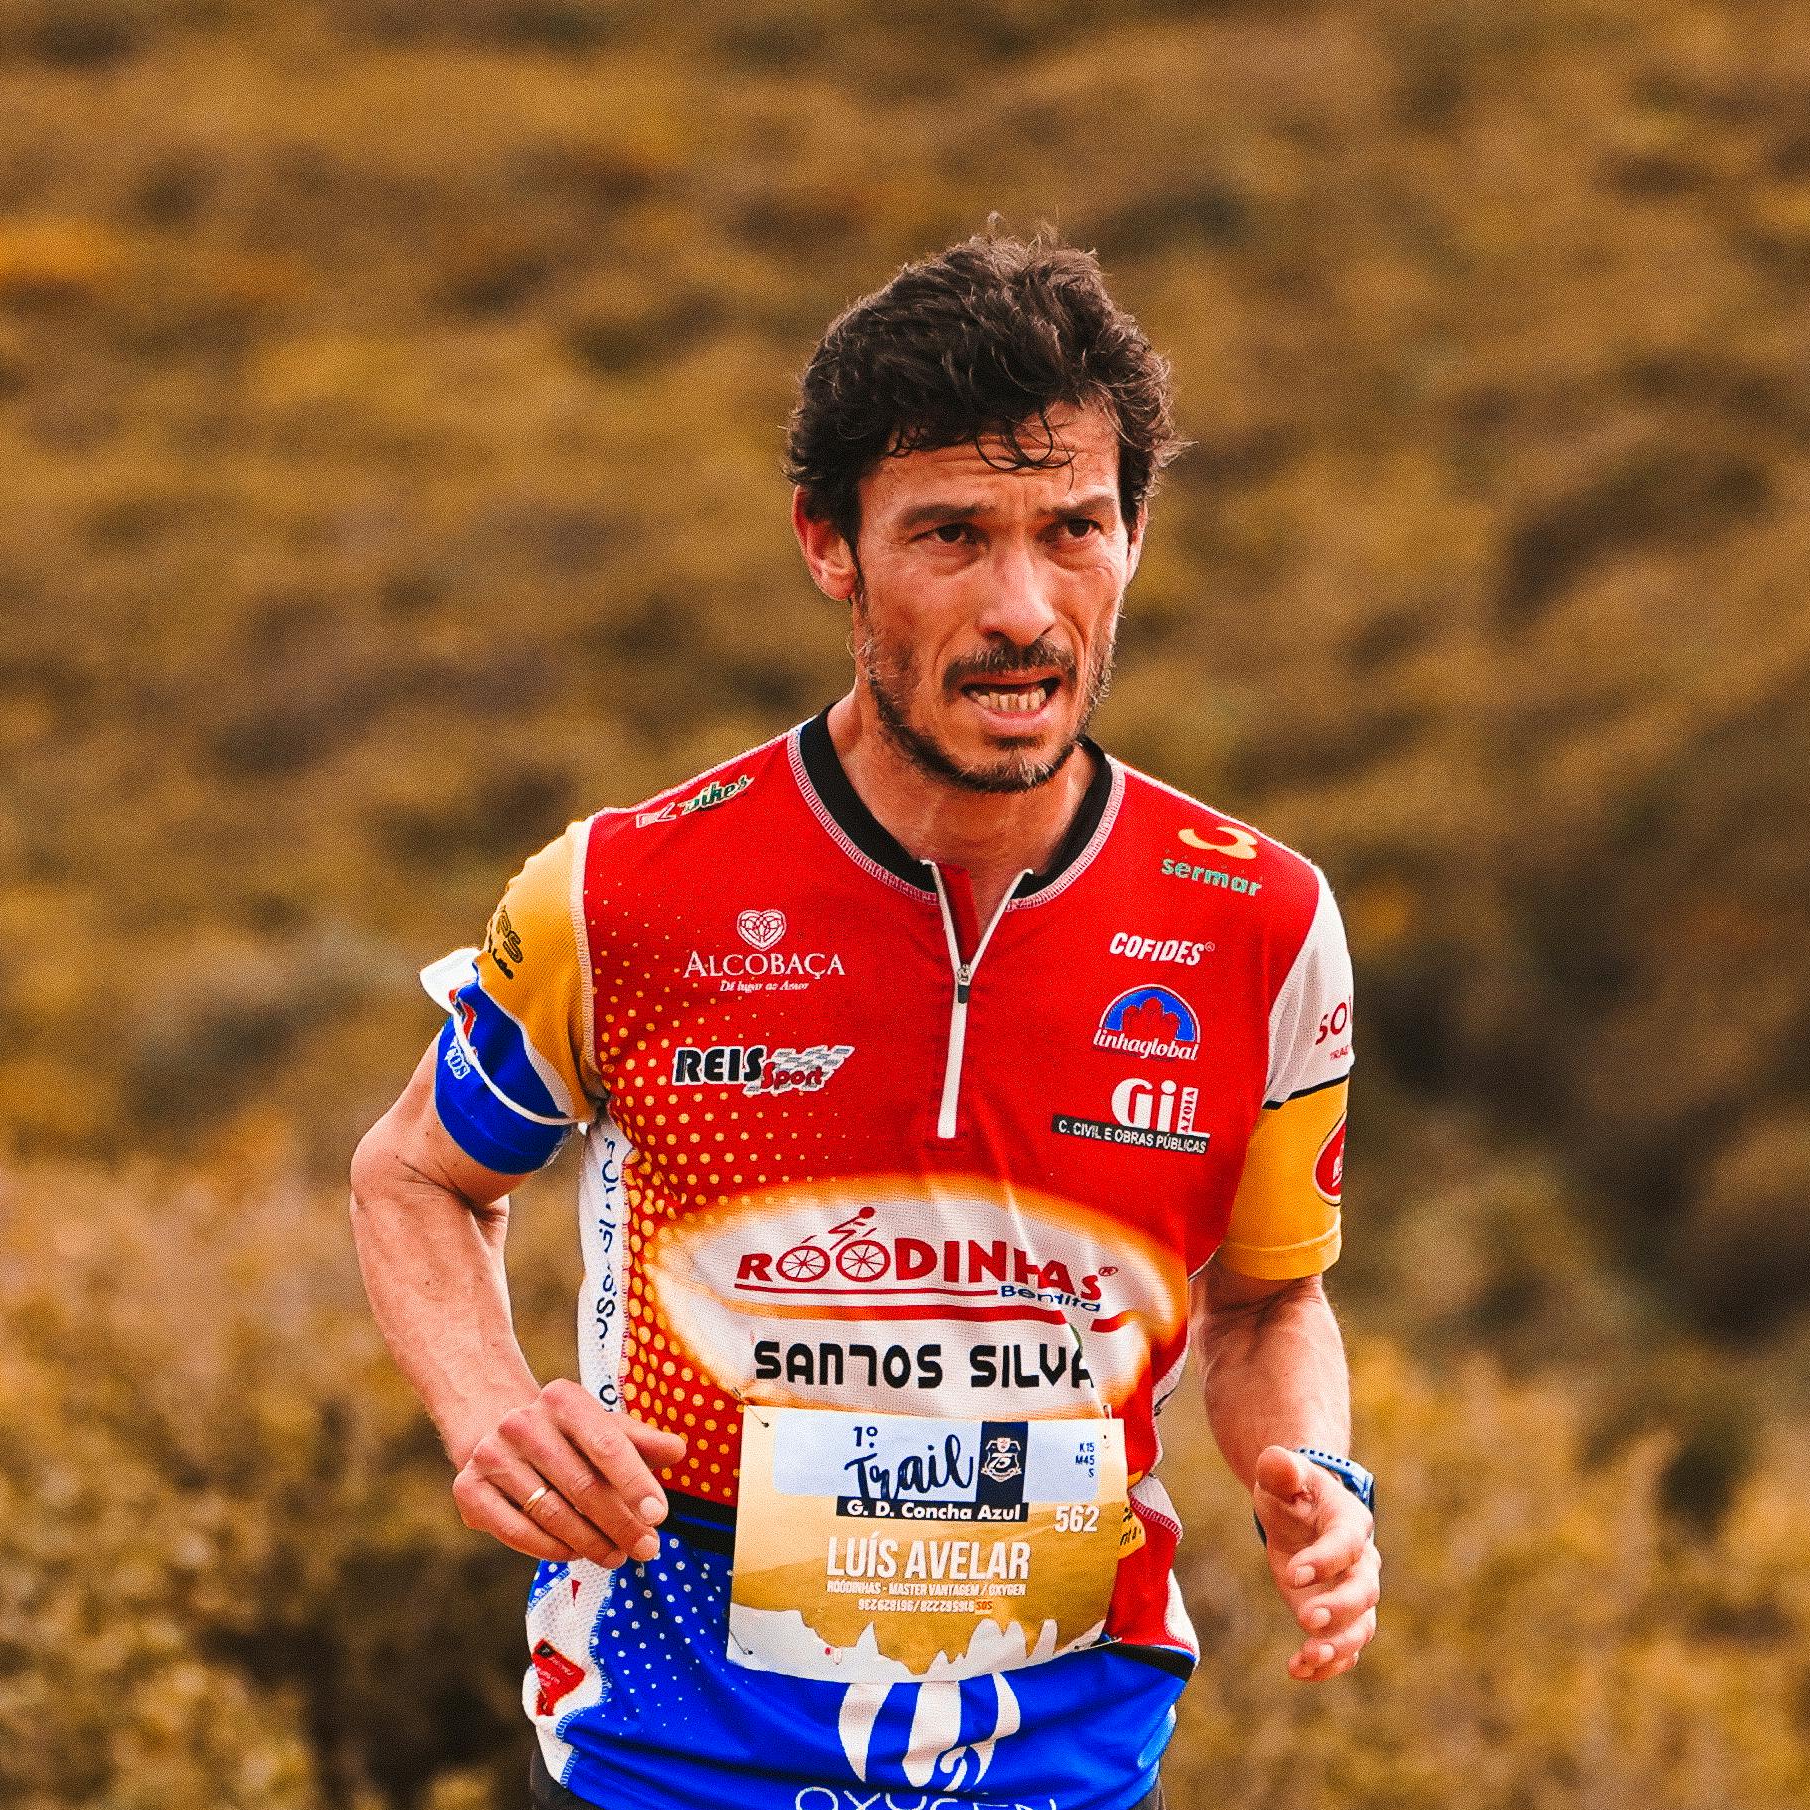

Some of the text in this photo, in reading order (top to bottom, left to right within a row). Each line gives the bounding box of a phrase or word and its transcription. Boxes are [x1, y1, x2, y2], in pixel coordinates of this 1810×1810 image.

[1161, 858, 1262, 896] sermar
[683, 951, 845, 979] ALCOBAÇA
[1093, 1029, 1200, 1061] linhaglobal
[674, 1048, 824, 1091] REIS Sport
[1058, 1119, 1207, 1154] C. CIVIL E OBRAS PÚBLICAS
[753, 1340, 1094, 1389] SANTOS SILVA
[844, 1434, 973, 1500] Trail
[1075, 1455, 1095, 1465] M45
[847, 1502, 1020, 1520] G. D. Concha Azul
[1054, 1505, 1099, 1533] 562
[826, 1531, 1031, 1580] LUÍS AVELAR
[889, 1583, 927, 1596] MASTER
[929, 1584, 979, 1596] VANTAGEM
[989, 1584, 1026, 1596] OXYGEN
